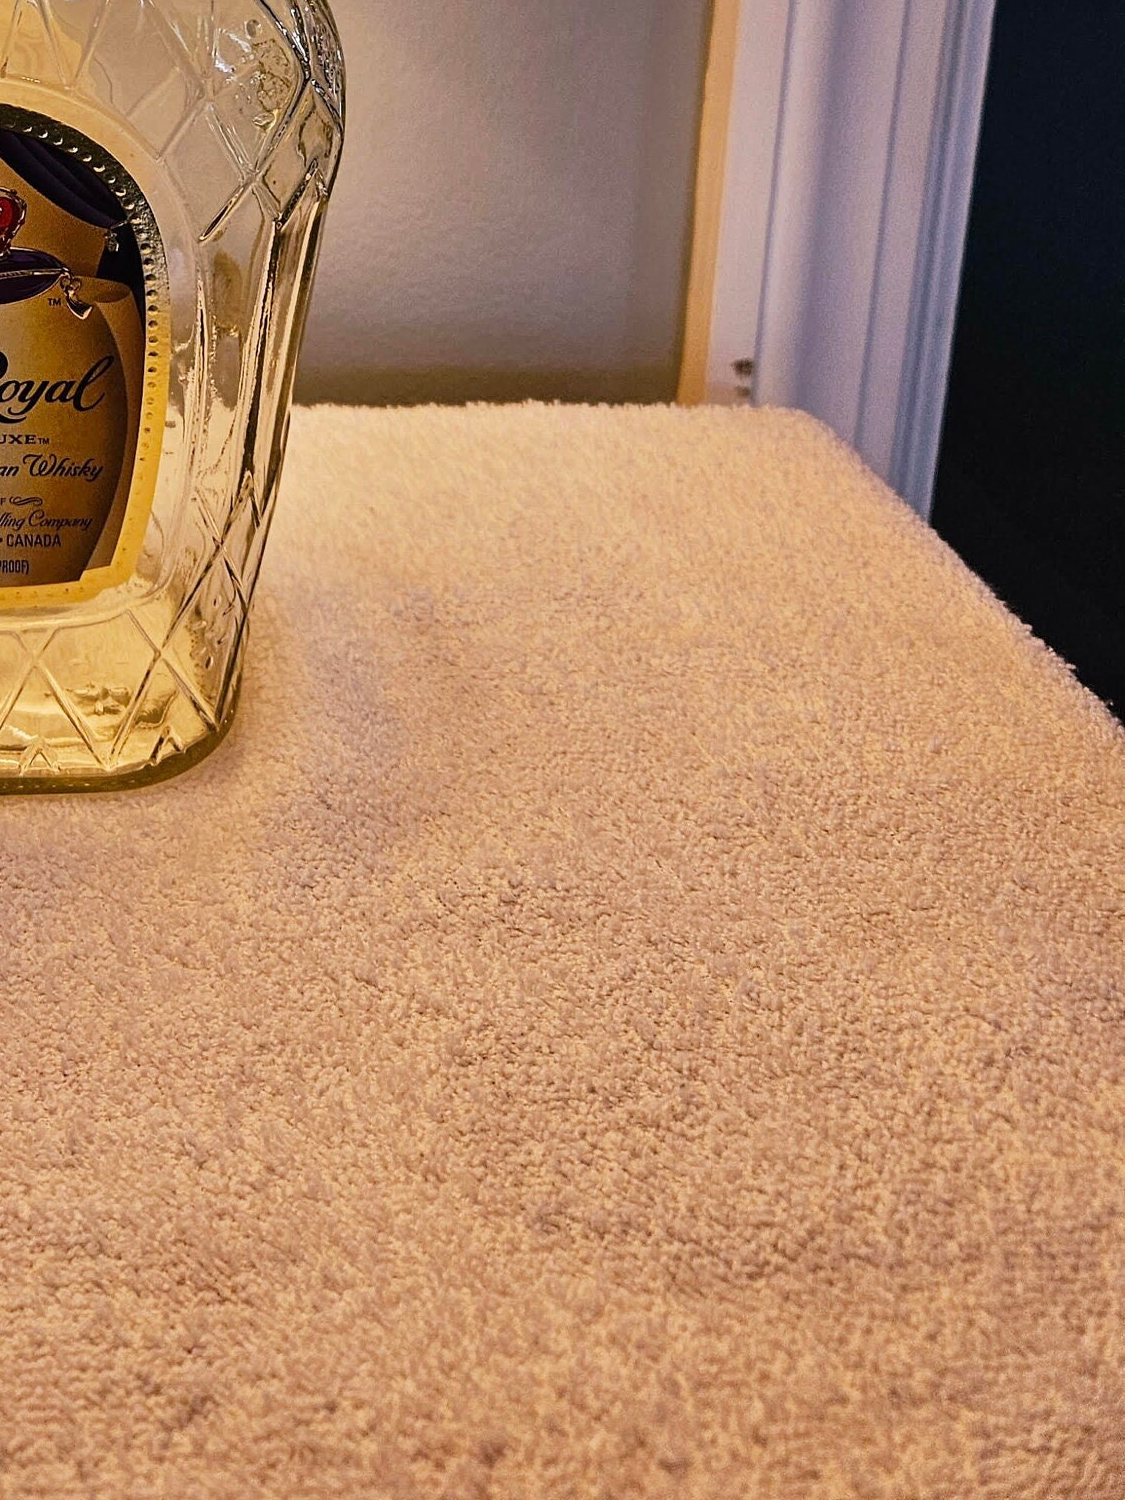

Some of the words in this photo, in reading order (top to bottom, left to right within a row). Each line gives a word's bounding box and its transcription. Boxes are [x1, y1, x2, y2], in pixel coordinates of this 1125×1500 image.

[22, 453, 104, 482] Whisky
[28, 509, 93, 532] Company
[6, 533, 62, 548] CANADA
